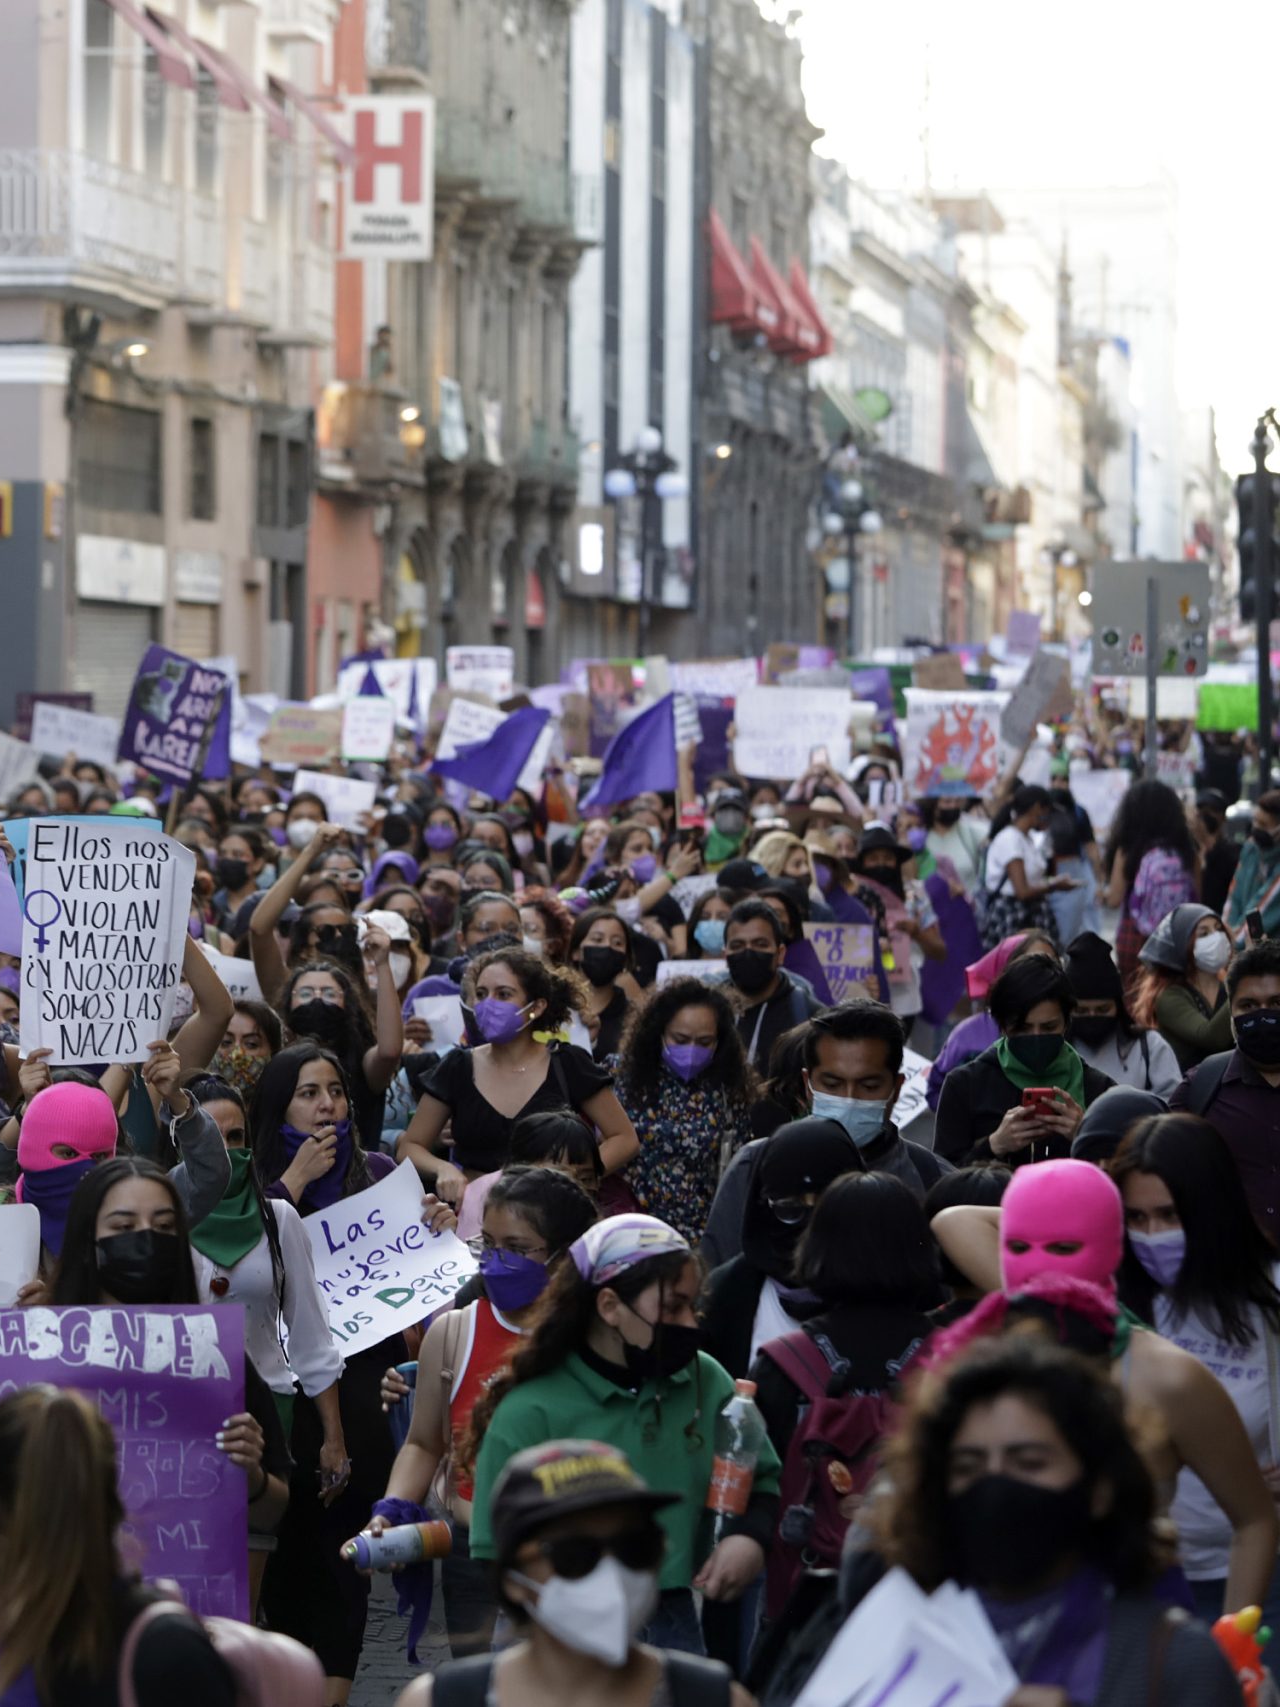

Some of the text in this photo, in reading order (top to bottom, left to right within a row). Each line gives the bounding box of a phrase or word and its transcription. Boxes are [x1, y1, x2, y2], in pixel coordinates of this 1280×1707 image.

[34, 824, 112, 863] Ellos
[125, 841, 171, 863] nos
[58, 862, 162, 893] VENDEN
[61, 899, 161, 932] VIOLAN
[58, 930, 157, 963] MATAN
[26, 954, 178, 992] ¿Y NOSOTRAS
[42, 990, 163, 1022] SOMOS LAS
[59, 1020, 139, 1060] NAZIS
[320, 1208, 385, 1255] Las
[156, 1519, 210, 1552] MI
